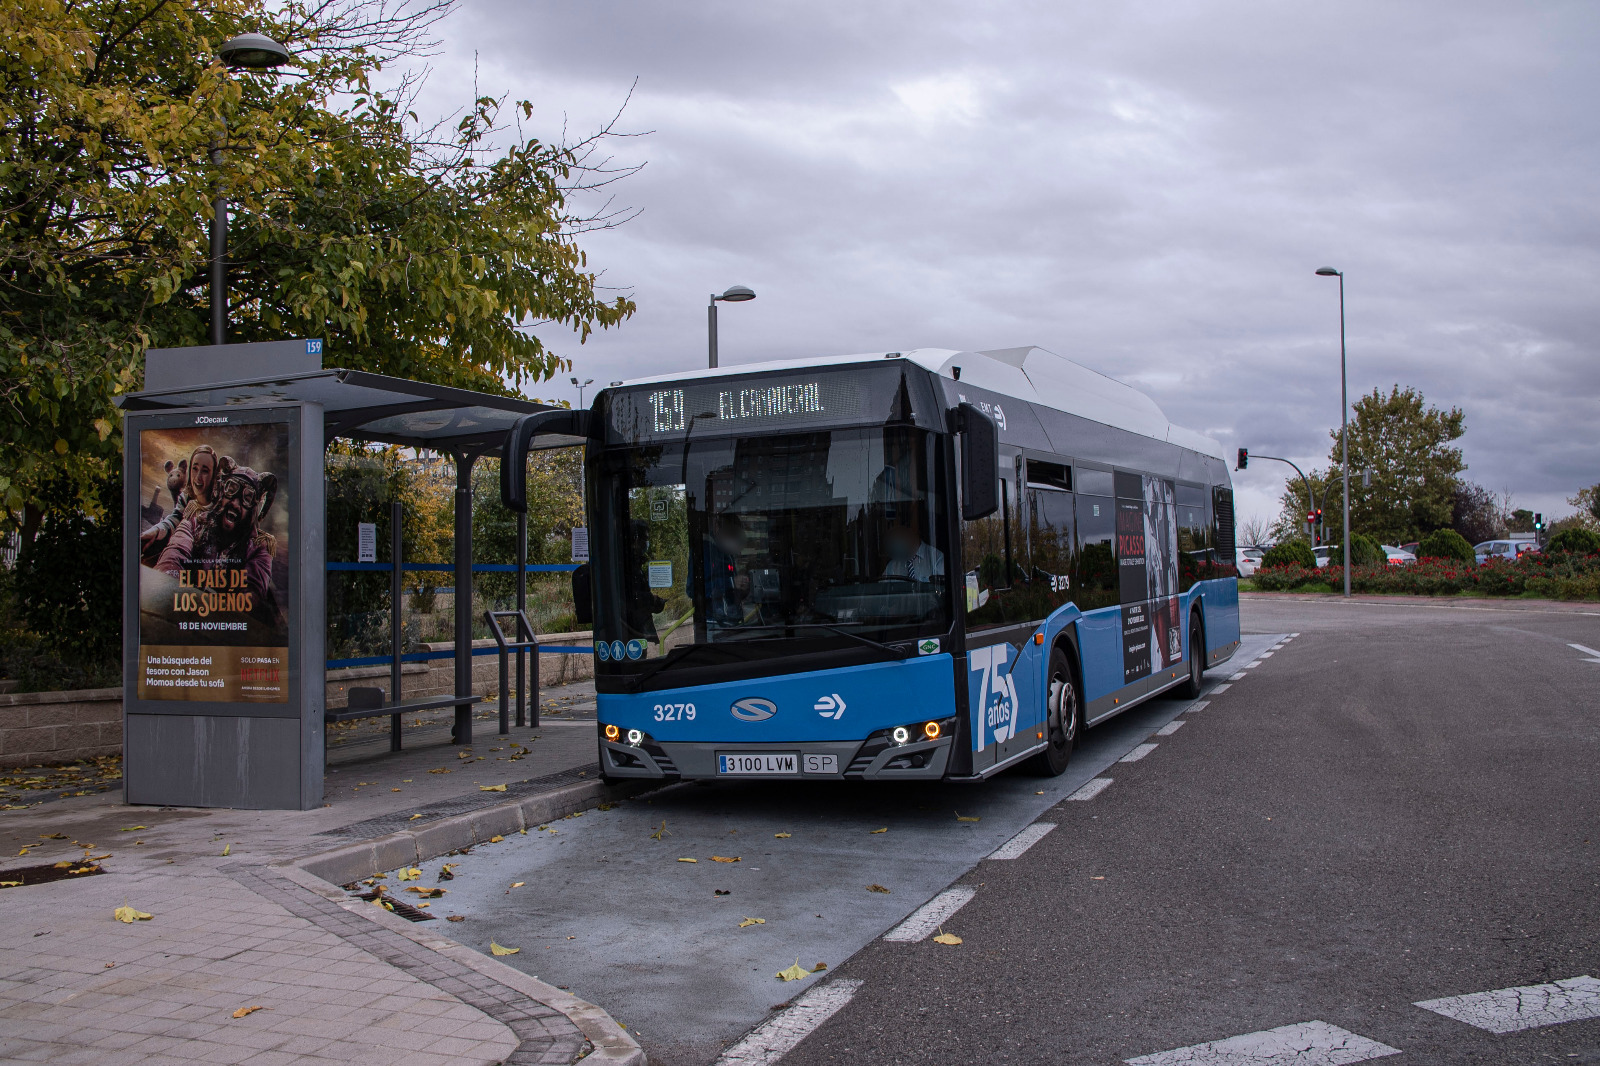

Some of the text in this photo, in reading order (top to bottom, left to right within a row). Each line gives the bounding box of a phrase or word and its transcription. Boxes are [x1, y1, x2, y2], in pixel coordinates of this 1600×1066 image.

[307, 341, 321, 353] 159
[649, 389, 684, 432] 159
[719, 391, 738, 420] EL
[195, 416, 229, 424] JCDecaux
[1119, 535, 1145, 556] PICASSO
[179, 565, 248, 588] EL PAÍS DE
[173, 589, 253, 617] LOS SUEÑOS
[179, 622, 248, 631] 18 DE NOVIEMBRE
[922, 643, 937, 651] GNC
[147, 656, 212, 666] Una búsqueda del
[240, 656, 256, 664] SOLO
[146, 667, 210, 676] tesoro con Jason
[240, 668, 280, 682] NETFLIX
[146, 678, 225, 688] Momoa desde tu sofá
[970, 643, 1009, 753] 75
[653, 703, 697, 722] 3279
[987, 699, 1010, 728] años
[727, 757, 793, 771] 3100 LVM
[808, 757, 833, 771] SP
